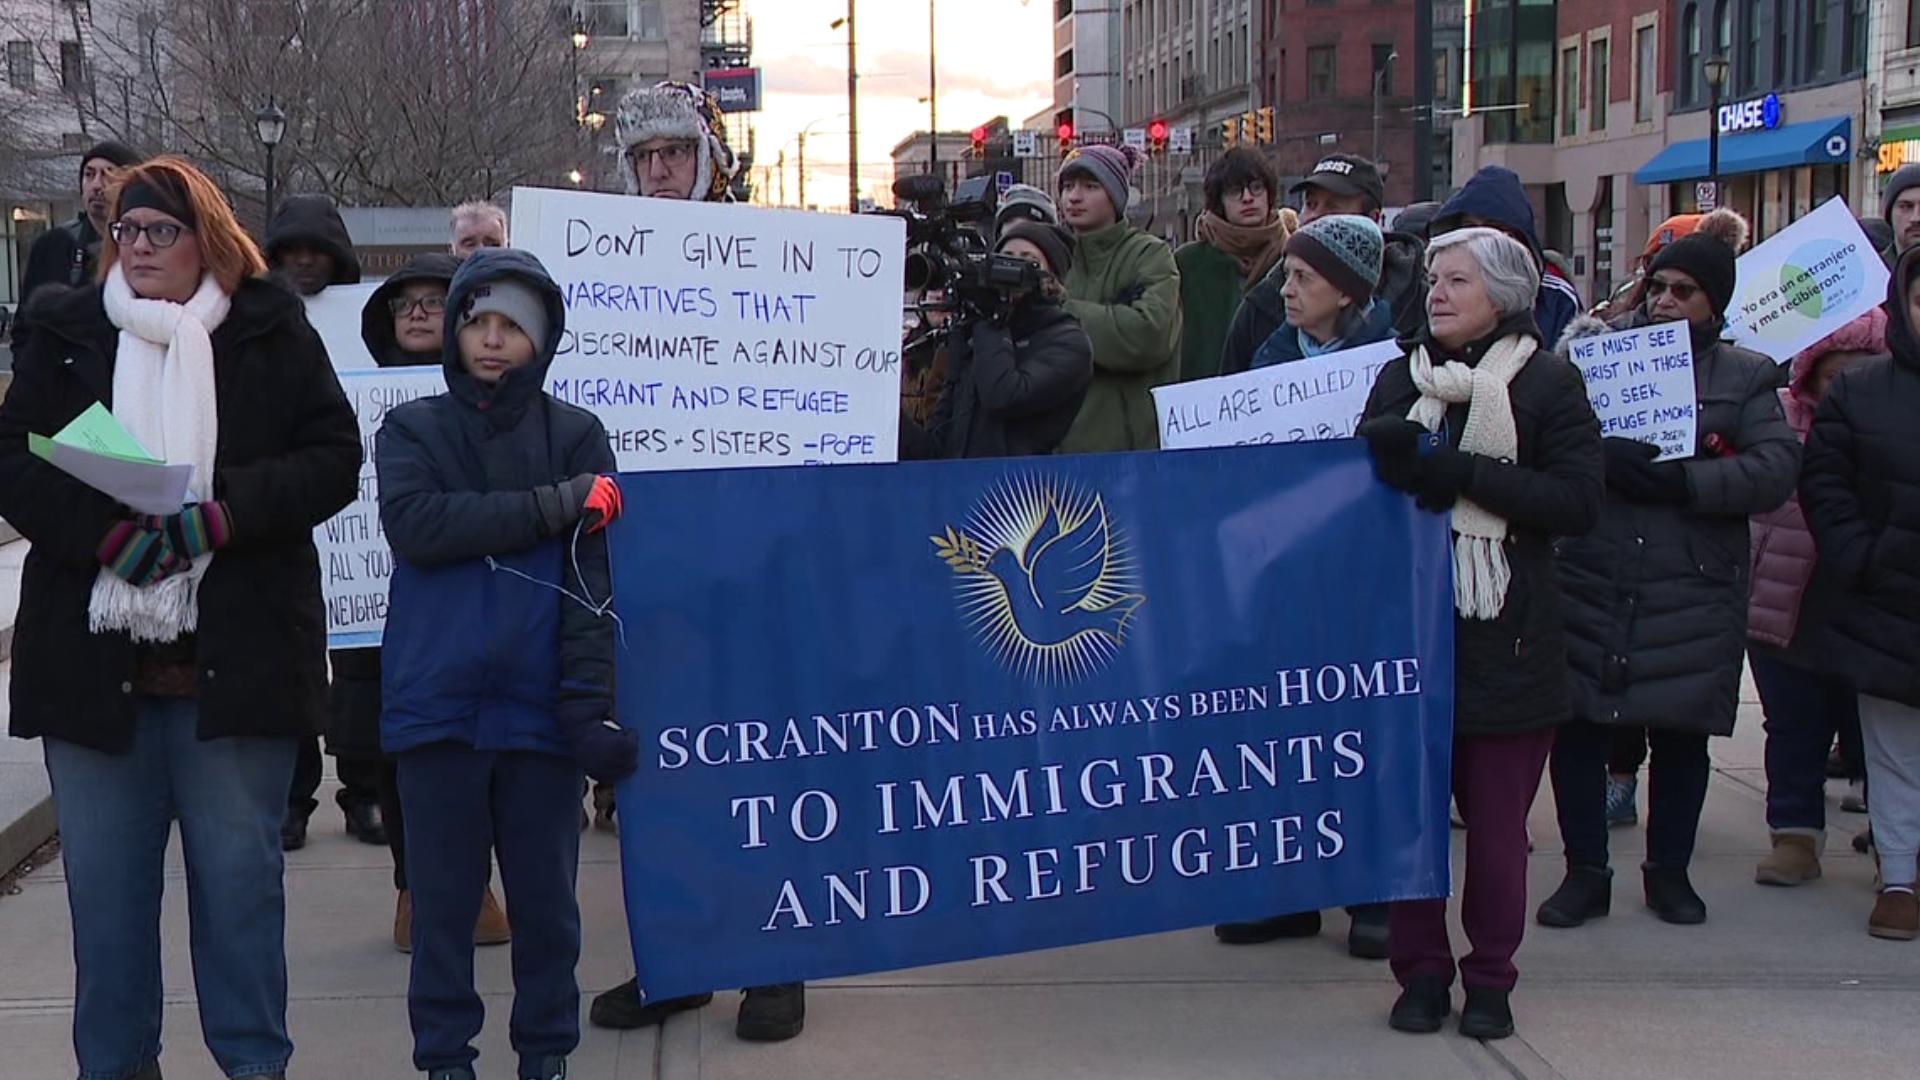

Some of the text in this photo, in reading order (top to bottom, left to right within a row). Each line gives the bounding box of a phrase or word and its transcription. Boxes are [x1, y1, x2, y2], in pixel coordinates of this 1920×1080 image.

[1718, 99, 1763, 132] CHASE
[1313, 160, 1353, 175] RESIST
[566, 218, 883, 279] DON'T GIVE IN TO
[1741, 302, 1758, 315] Yo
[1759, 291, 1779, 306] era
[1779, 280, 1796, 294] un
[1796, 243, 1857, 284] extranjero
[561, 281, 817, 323] NARRATIVES THAT
[1749, 322, 1759, 335] y
[1759, 310, 1780, 327] me
[555, 329, 899, 374] DISCRIMINATE AGAINST OUR
[1574, 329, 1675, 359] WE MUST SEE
[1582, 352, 1690, 383] HRIST IN THOSE
[672, 385, 730, 411] AND
[737, 385, 849, 416] REFUGEE
[1166, 405, 1211, 436] ALL
[1218, 389, 1262, 422] ARE
[1273, 369, 1355, 407] CALLED
[1592, 382, 1662, 411] HO SEEK
[1600, 405, 1693, 434] EFUGE AMONG
[605, 428, 668, 453] HERS
[691, 428, 792, 456] SISTERS
[326, 512, 369, 543] WITH
[330, 550, 391, 586] ALL YOU
[329, 593, 389, 629] NEIGHB
[658, 657, 1422, 770] SCRANTON HAS ALWAYS BEEN HOME
[730, 729, 1366, 849] TO IMMIGRANTS
[761, 809, 1345, 932] AND REFUGEES
